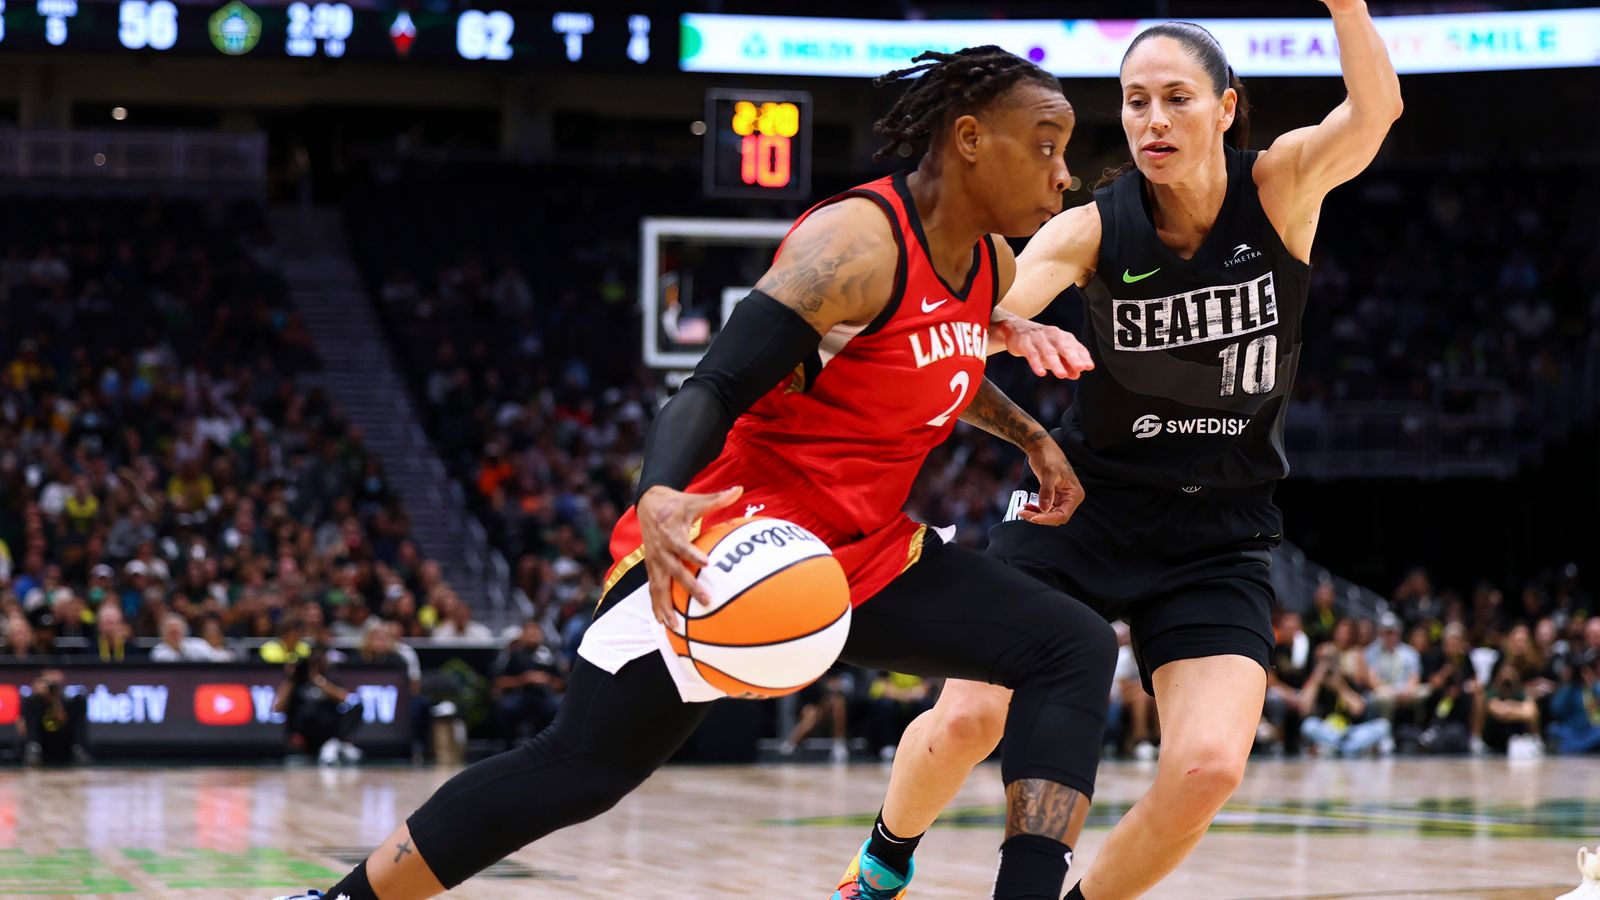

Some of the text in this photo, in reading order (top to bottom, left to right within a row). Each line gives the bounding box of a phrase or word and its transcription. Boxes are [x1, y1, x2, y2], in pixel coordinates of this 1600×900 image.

[457, 10, 515, 60] 62
[740, 134, 791, 188] 10
[1223, 250, 1263, 268] SYMETRA
[1115, 276, 1276, 349] SEATTLE
[908, 322, 955, 369] LAS
[1218, 334, 1278, 397] 10
[925, 370, 970, 427] 2
[714, 525, 818, 573] Wilson
